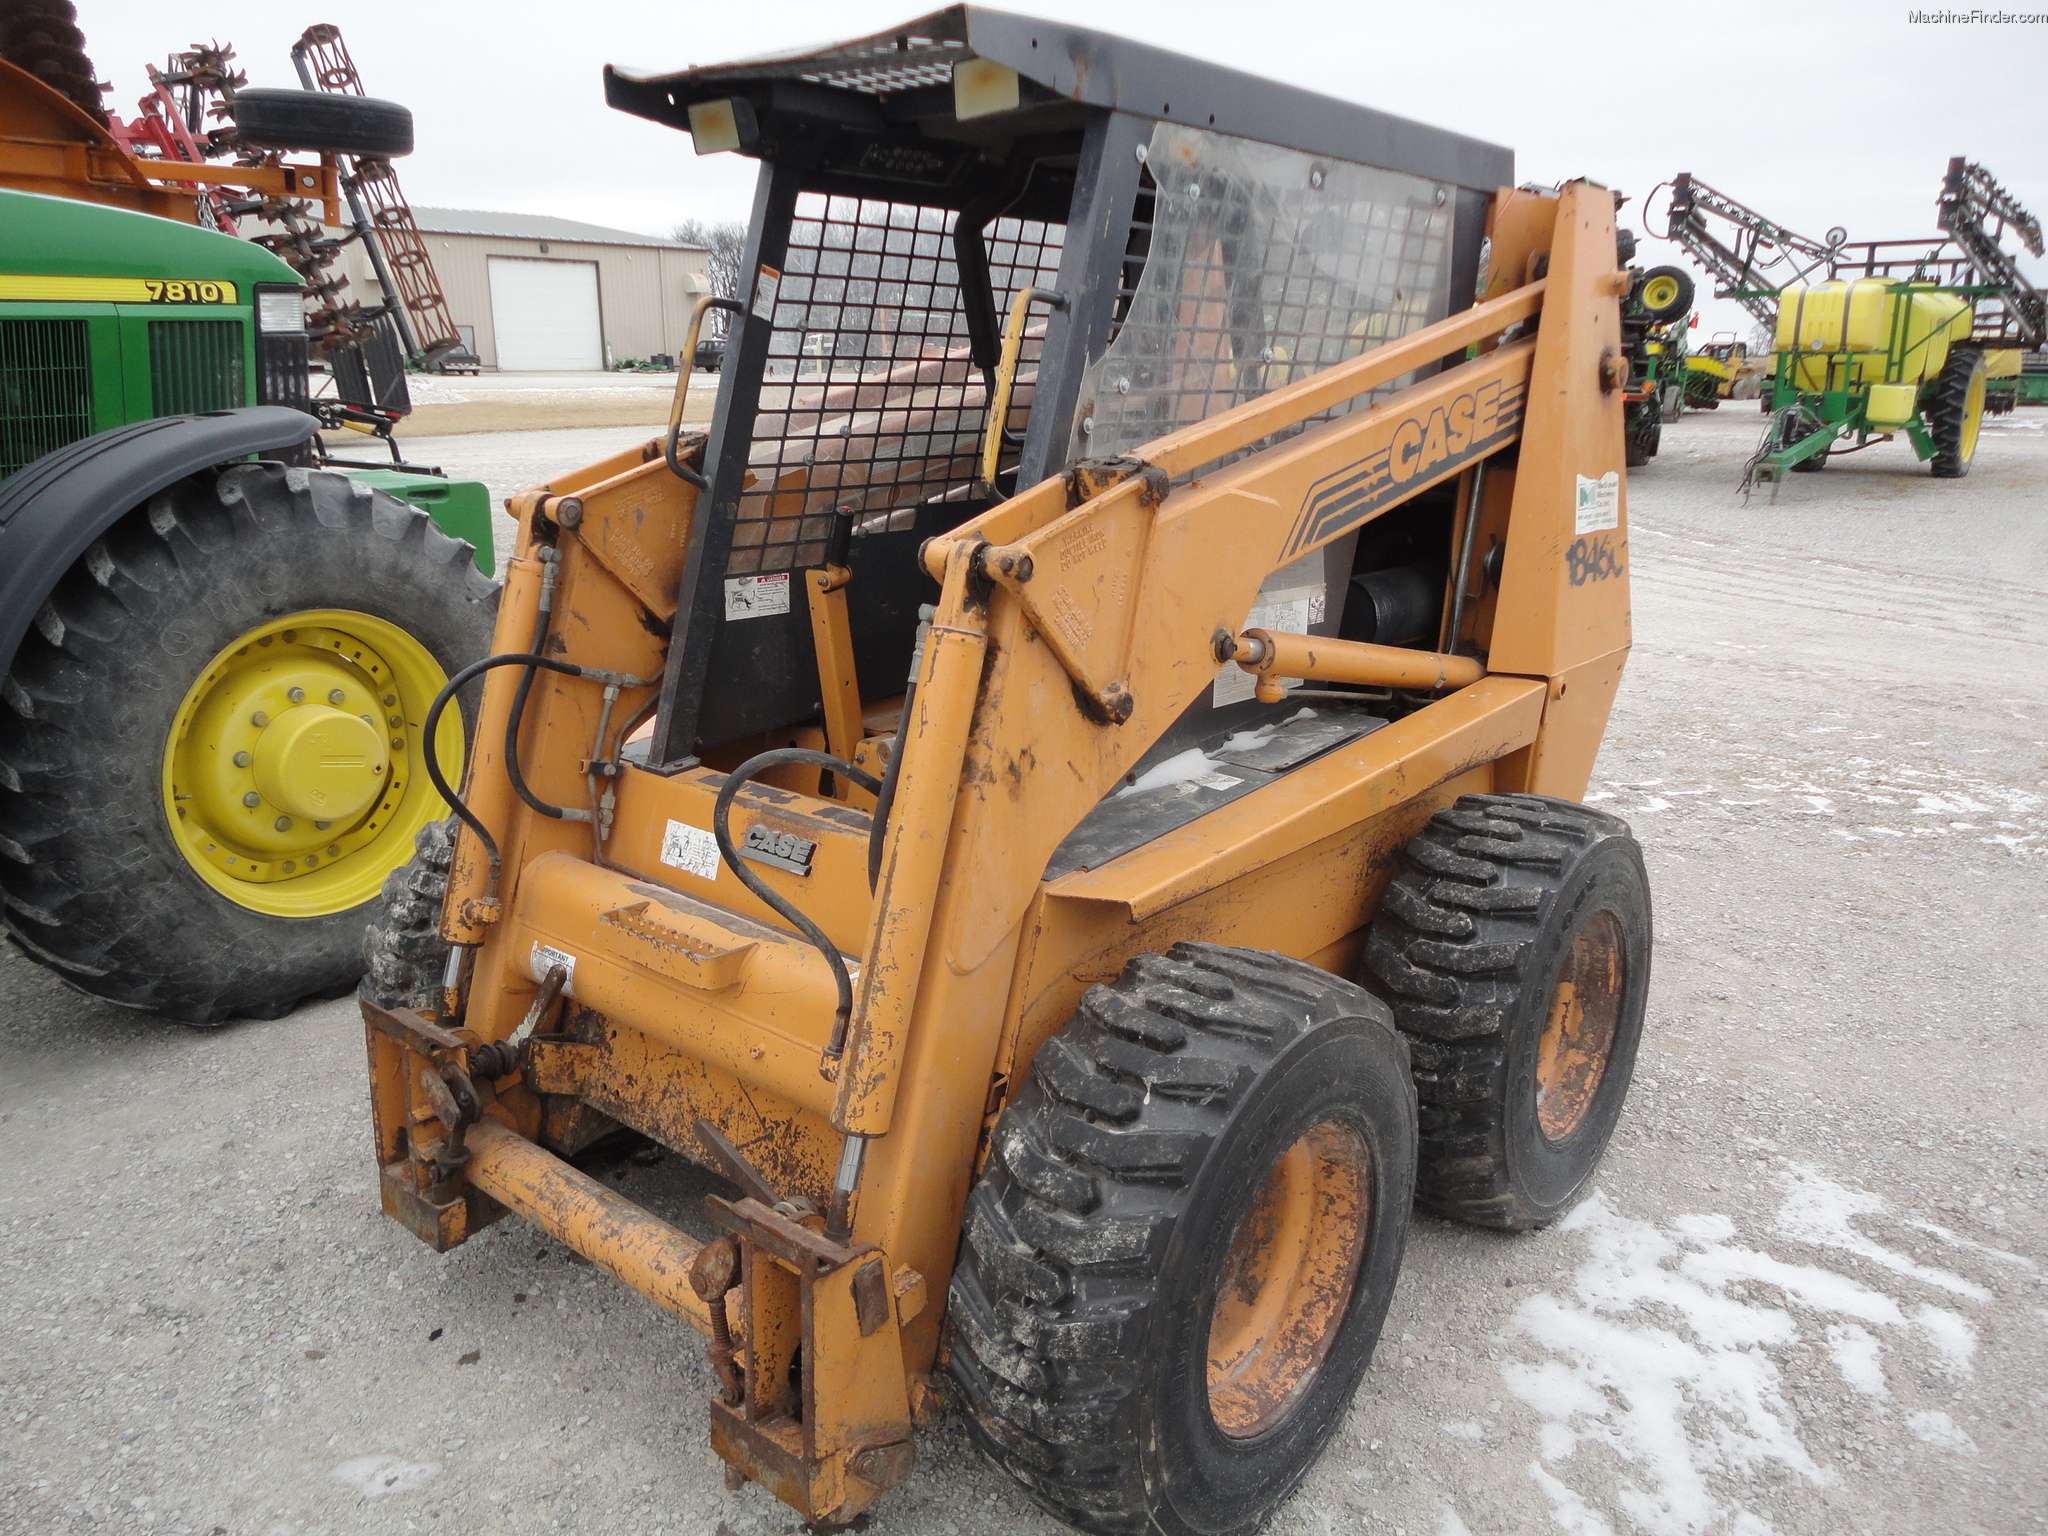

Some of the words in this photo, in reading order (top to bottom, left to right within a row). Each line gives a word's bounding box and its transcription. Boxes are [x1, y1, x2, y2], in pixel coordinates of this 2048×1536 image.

[145, 281, 224, 303] 7810
[1388, 378, 1502, 484] CASE
[744, 824, 817, 866] CASE
[540, 947, 569, 963] MPORTANT
